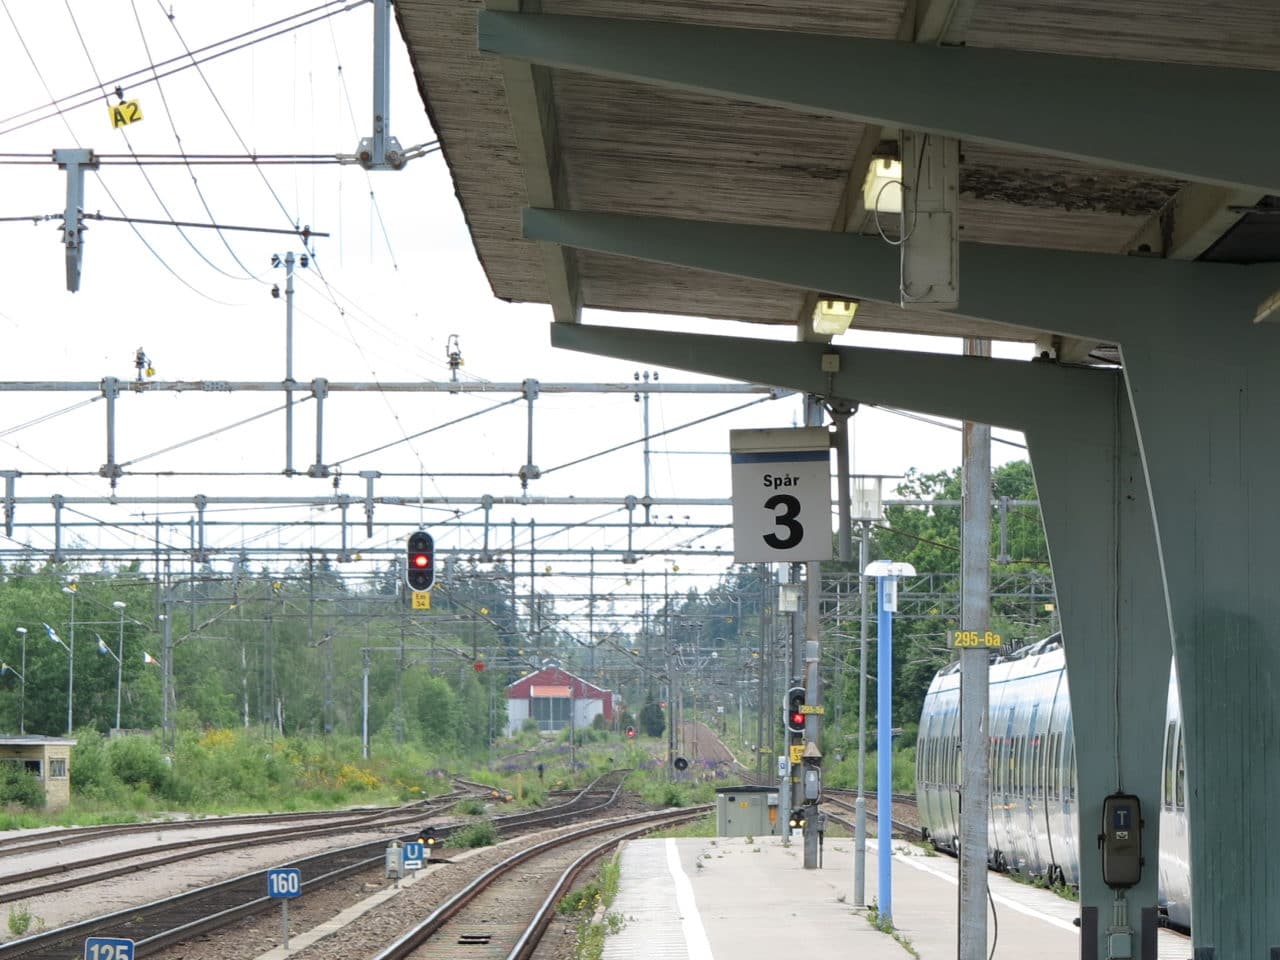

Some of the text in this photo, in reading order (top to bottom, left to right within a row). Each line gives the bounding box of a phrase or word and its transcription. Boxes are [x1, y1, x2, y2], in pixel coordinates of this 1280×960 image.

[113, 102, 142, 128] A2
[763, 473, 800, 490] Spår
[762, 494, 804, 550] 3
[954, 631, 1001, 647] 295-6a
[1116, 810, 1127, 826] T
[407, 845, 419, 859] U
[270, 873, 299, 894] 160
